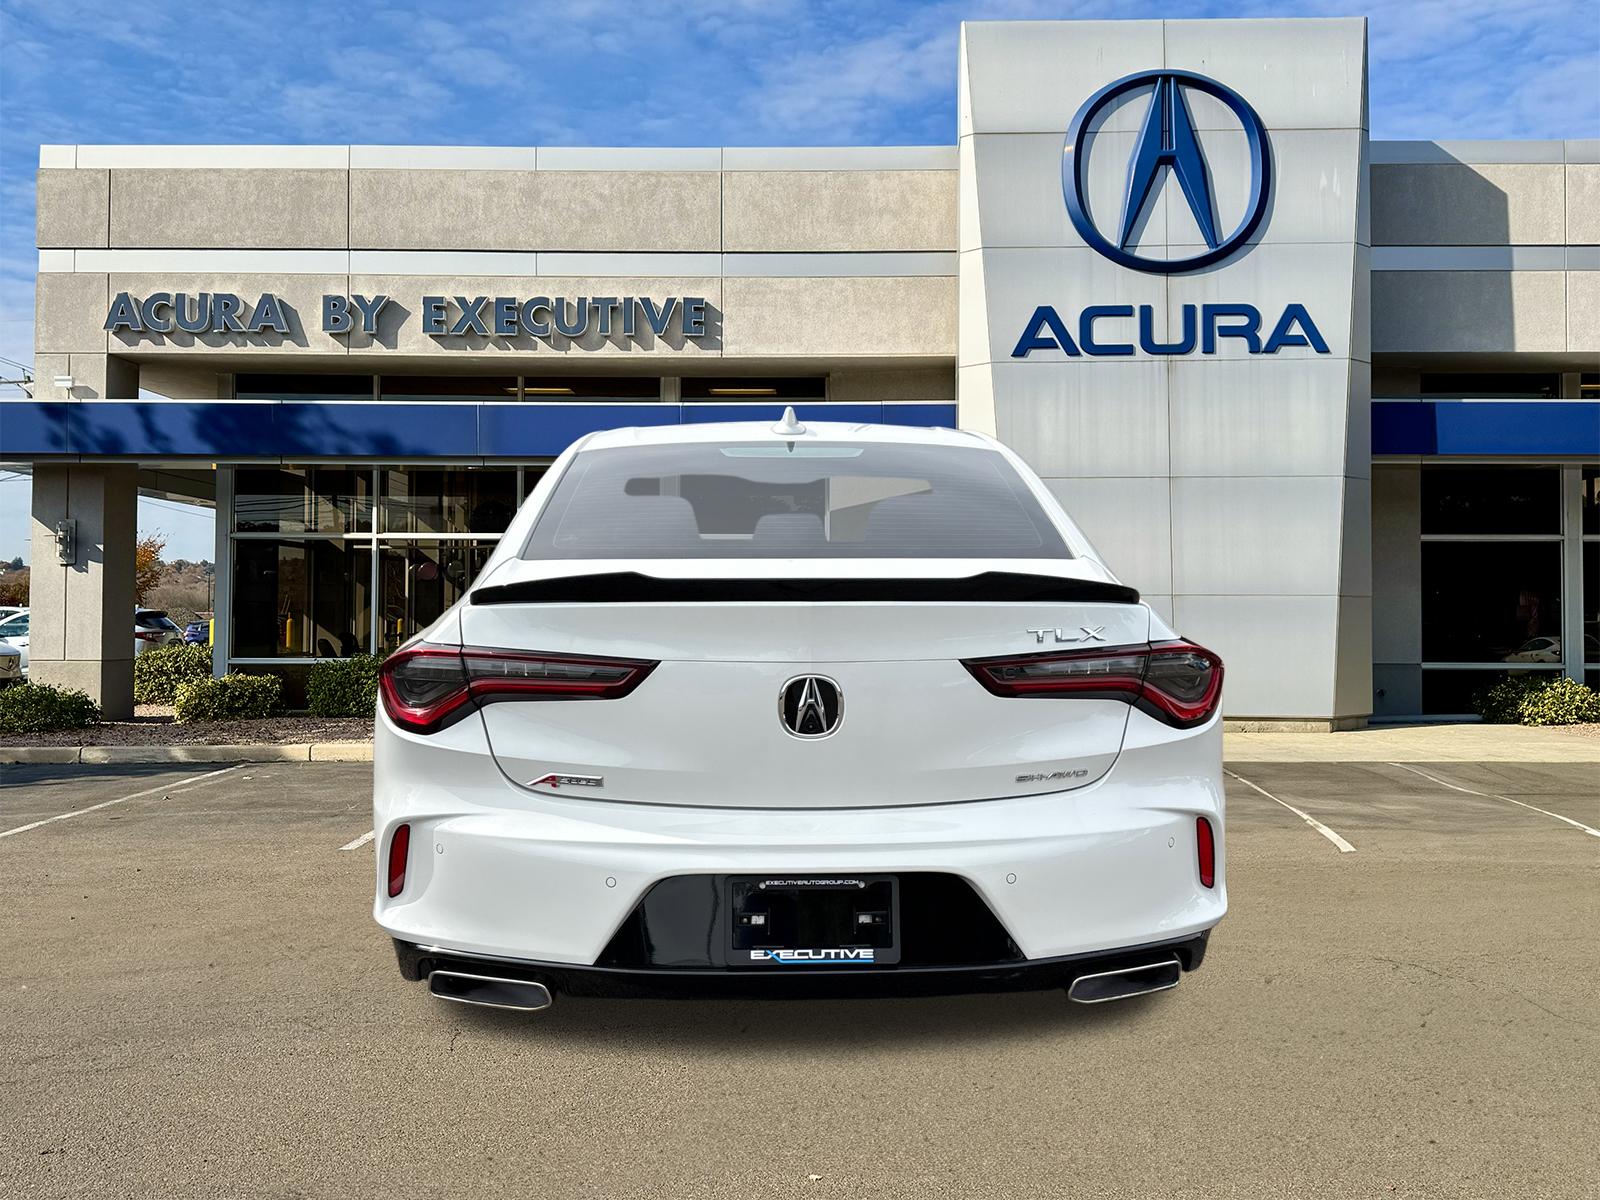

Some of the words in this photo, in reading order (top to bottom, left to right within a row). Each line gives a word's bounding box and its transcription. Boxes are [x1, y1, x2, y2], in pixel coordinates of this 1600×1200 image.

[104, 292, 290, 334] ACURA
[321, 293, 391, 335] BY
[422, 295, 708, 338] EXECUTIVE
[1010, 303, 1333, 357] ACURA
[1026, 626, 1106, 644] TLX
[750, 949, 875, 964] EXECUTIVE
